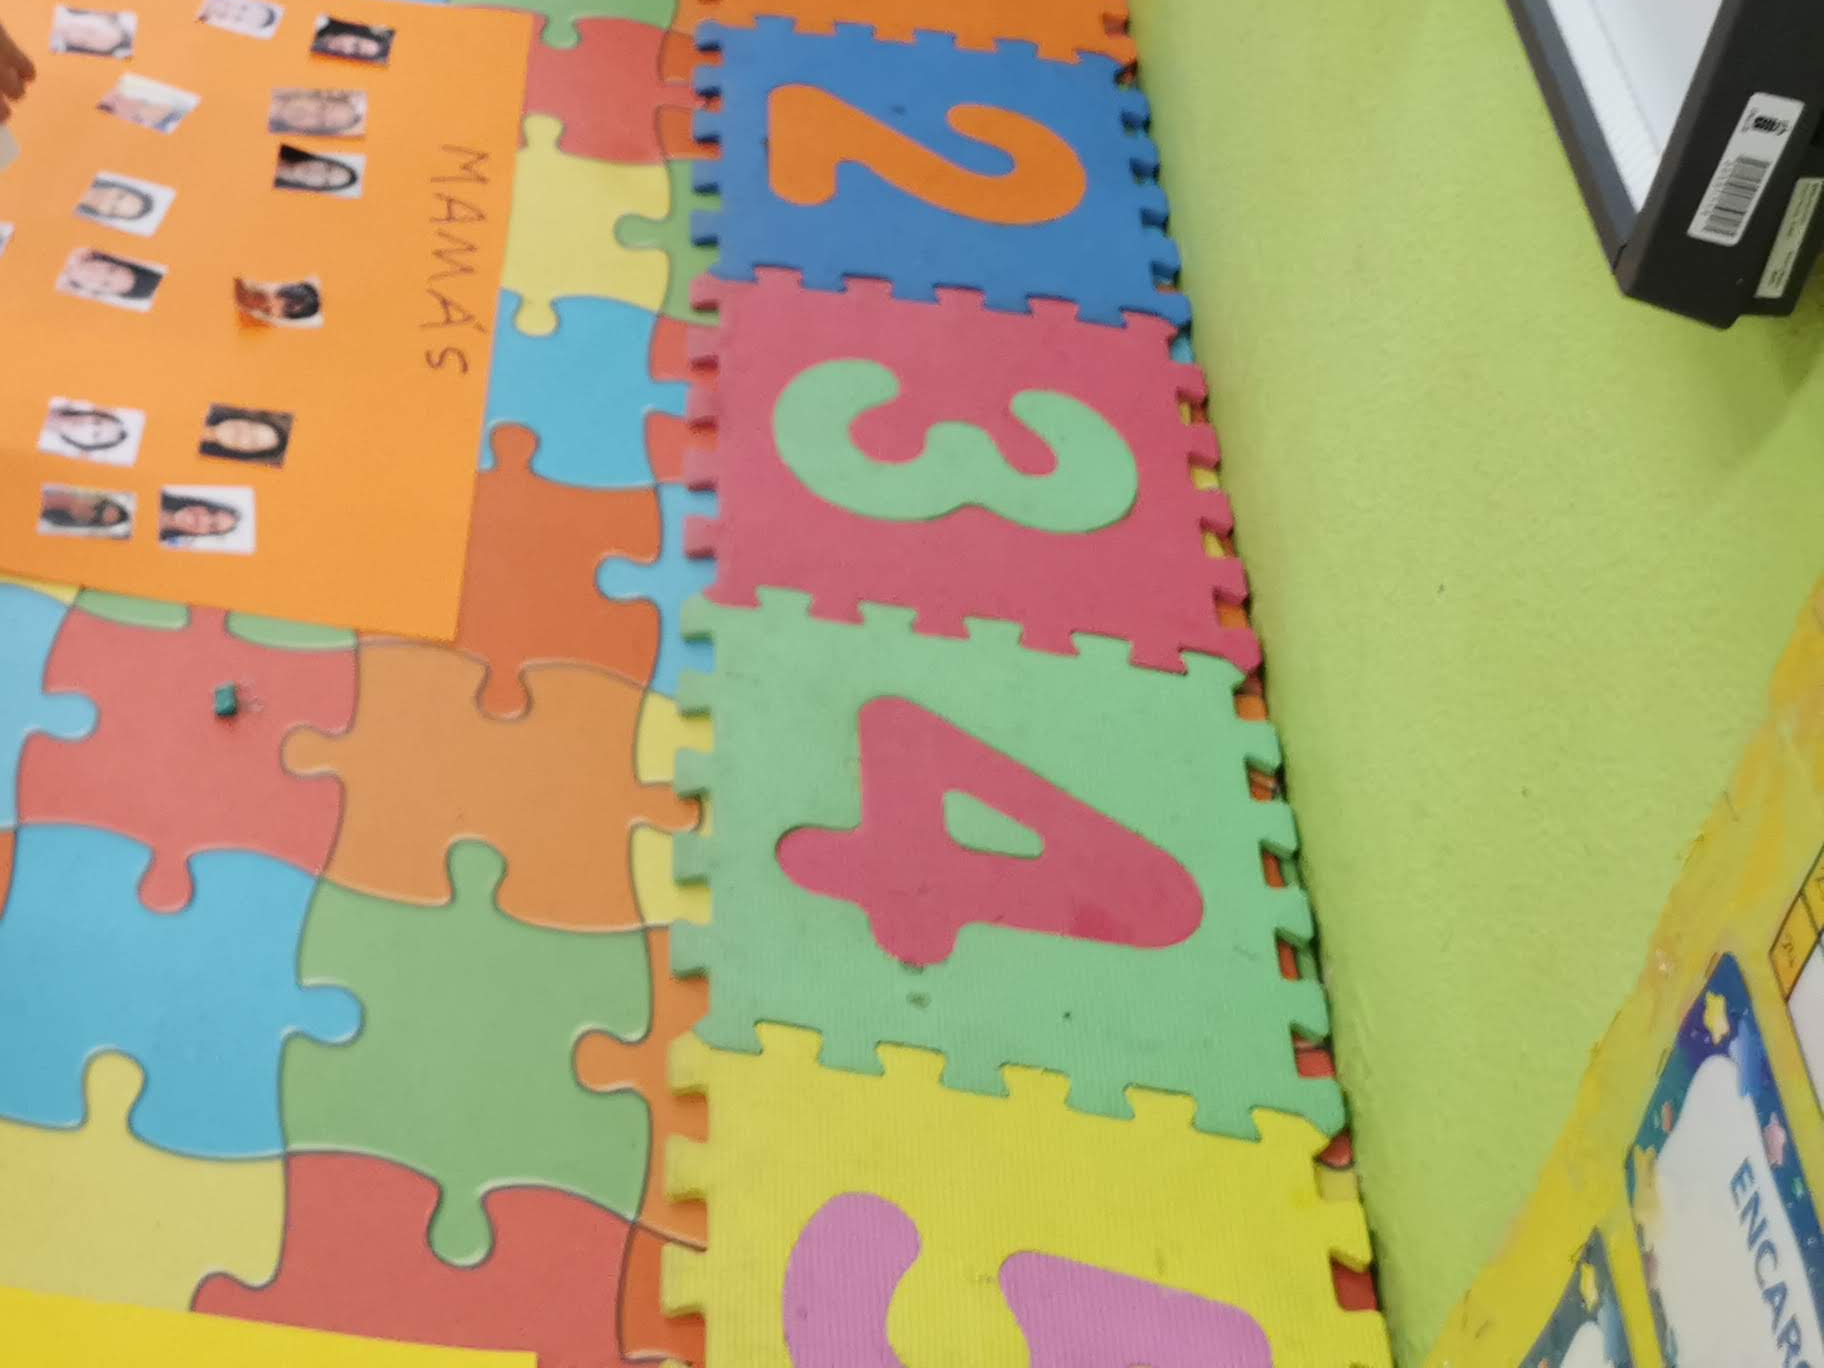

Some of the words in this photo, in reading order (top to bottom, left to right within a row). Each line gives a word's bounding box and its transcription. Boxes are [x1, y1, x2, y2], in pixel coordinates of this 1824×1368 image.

[768, 84, 1087, 225] 2
[773, 358, 1138, 533] 3
[776, 694, 1205, 966] 4
[1730, 1157, 1809, 1368] ENCAR
